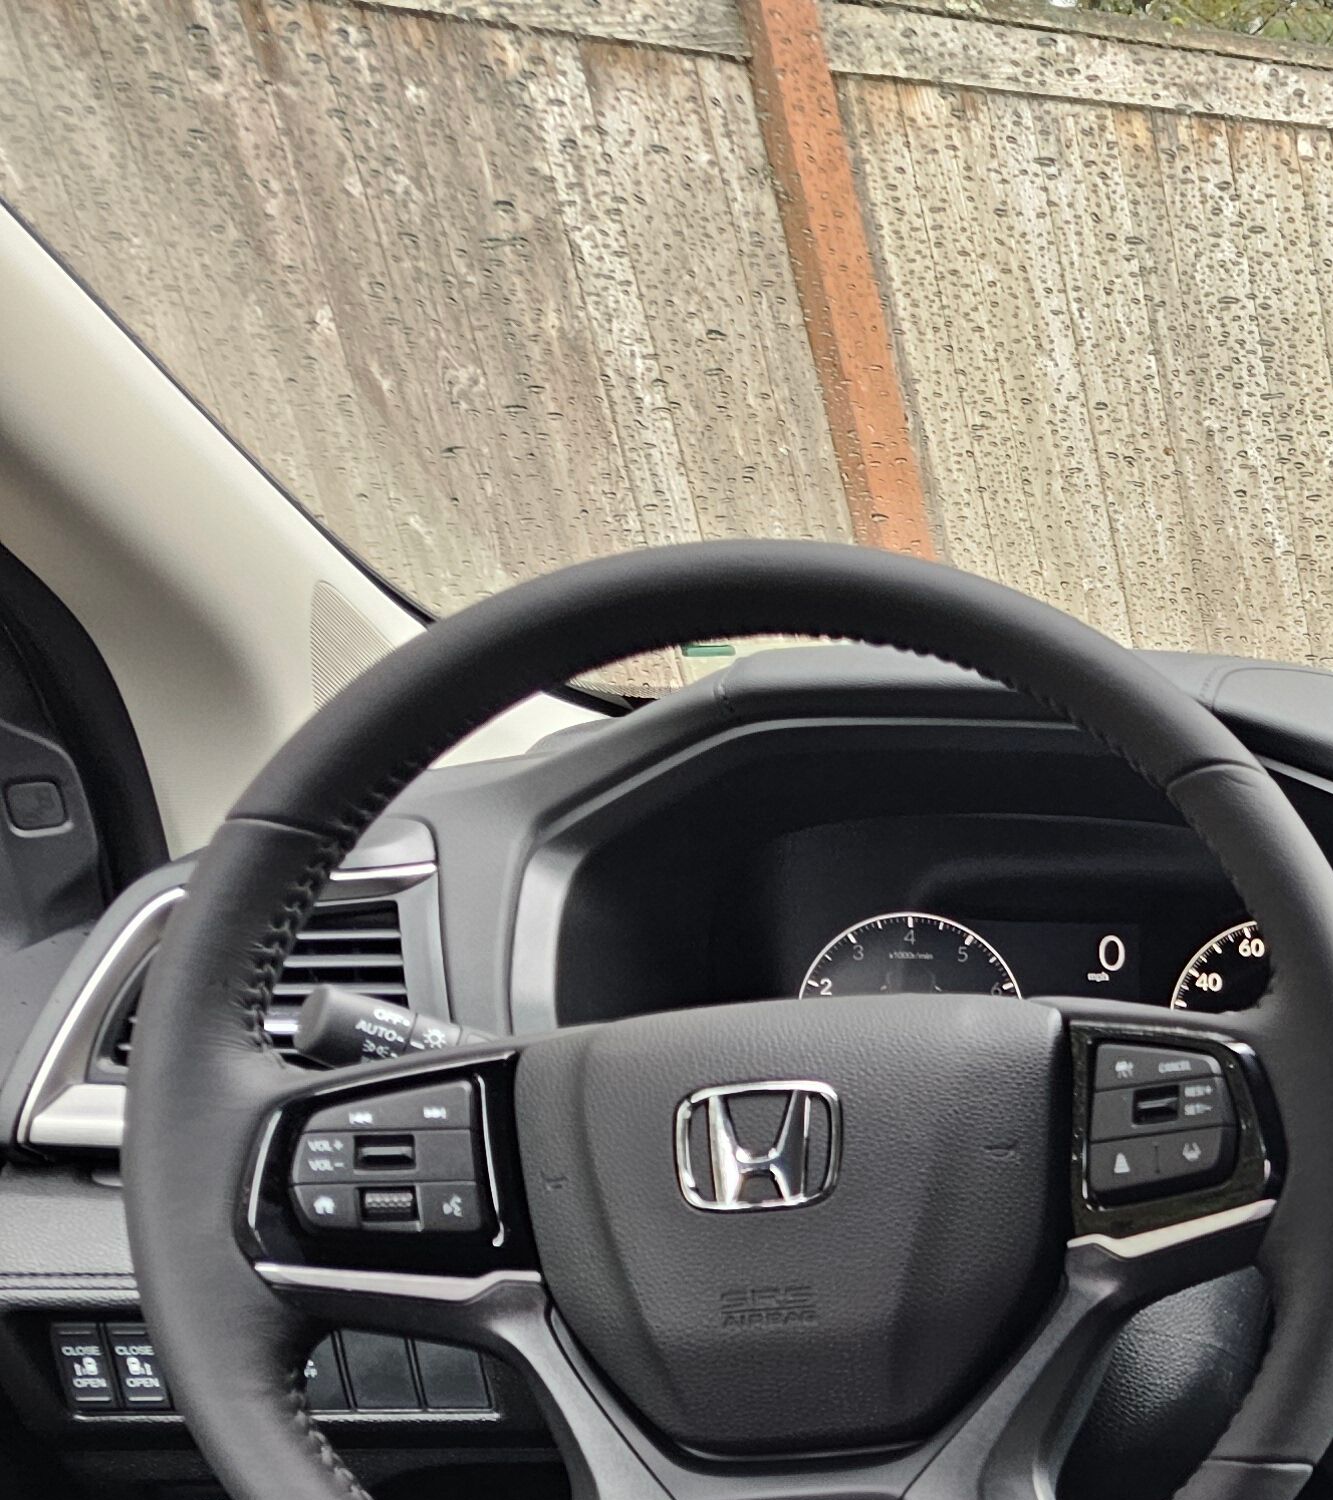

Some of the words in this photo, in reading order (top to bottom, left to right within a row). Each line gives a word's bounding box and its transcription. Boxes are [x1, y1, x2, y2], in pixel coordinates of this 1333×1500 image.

[904, 929, 916, 945] 4
[853, 945, 864, 961] 3
[957, 947, 968, 962] 5
[1098, 934, 1126, 972] 0
[1238, 938, 1265, 957] 60
[820, 978, 833, 995] 2
[1195, 972, 1223, 992] 40
[355, 1019, 397, 1042] AUTO
[61, 1345, 102, 1357] CLOSE
[114, 1345, 155, 1357] CLOSE
[72, 1377, 108, 1388] OPEN
[125, 1377, 160, 1388] OPEN
